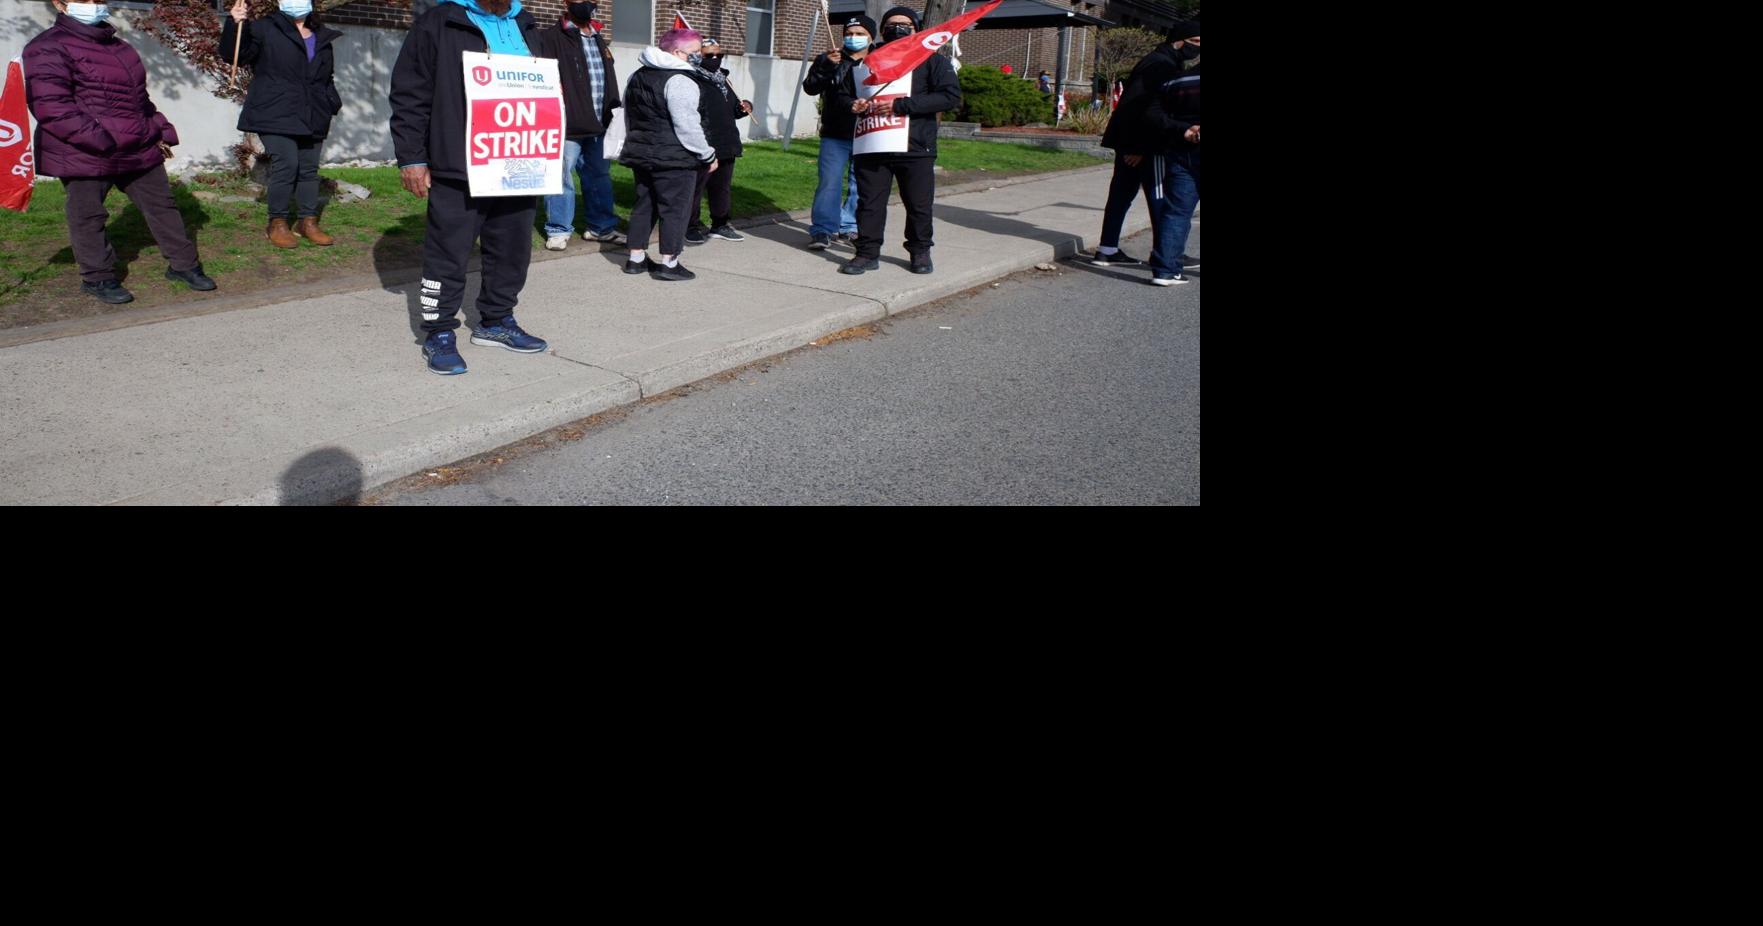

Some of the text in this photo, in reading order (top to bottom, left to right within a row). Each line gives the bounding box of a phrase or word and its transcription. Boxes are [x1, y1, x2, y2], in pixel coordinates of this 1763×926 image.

[496, 70, 545, 83] UNIFOR
[494, 101, 536, 128] ON
[855, 116, 903, 134] STRIKE
[473, 129, 560, 159] STRIKE
